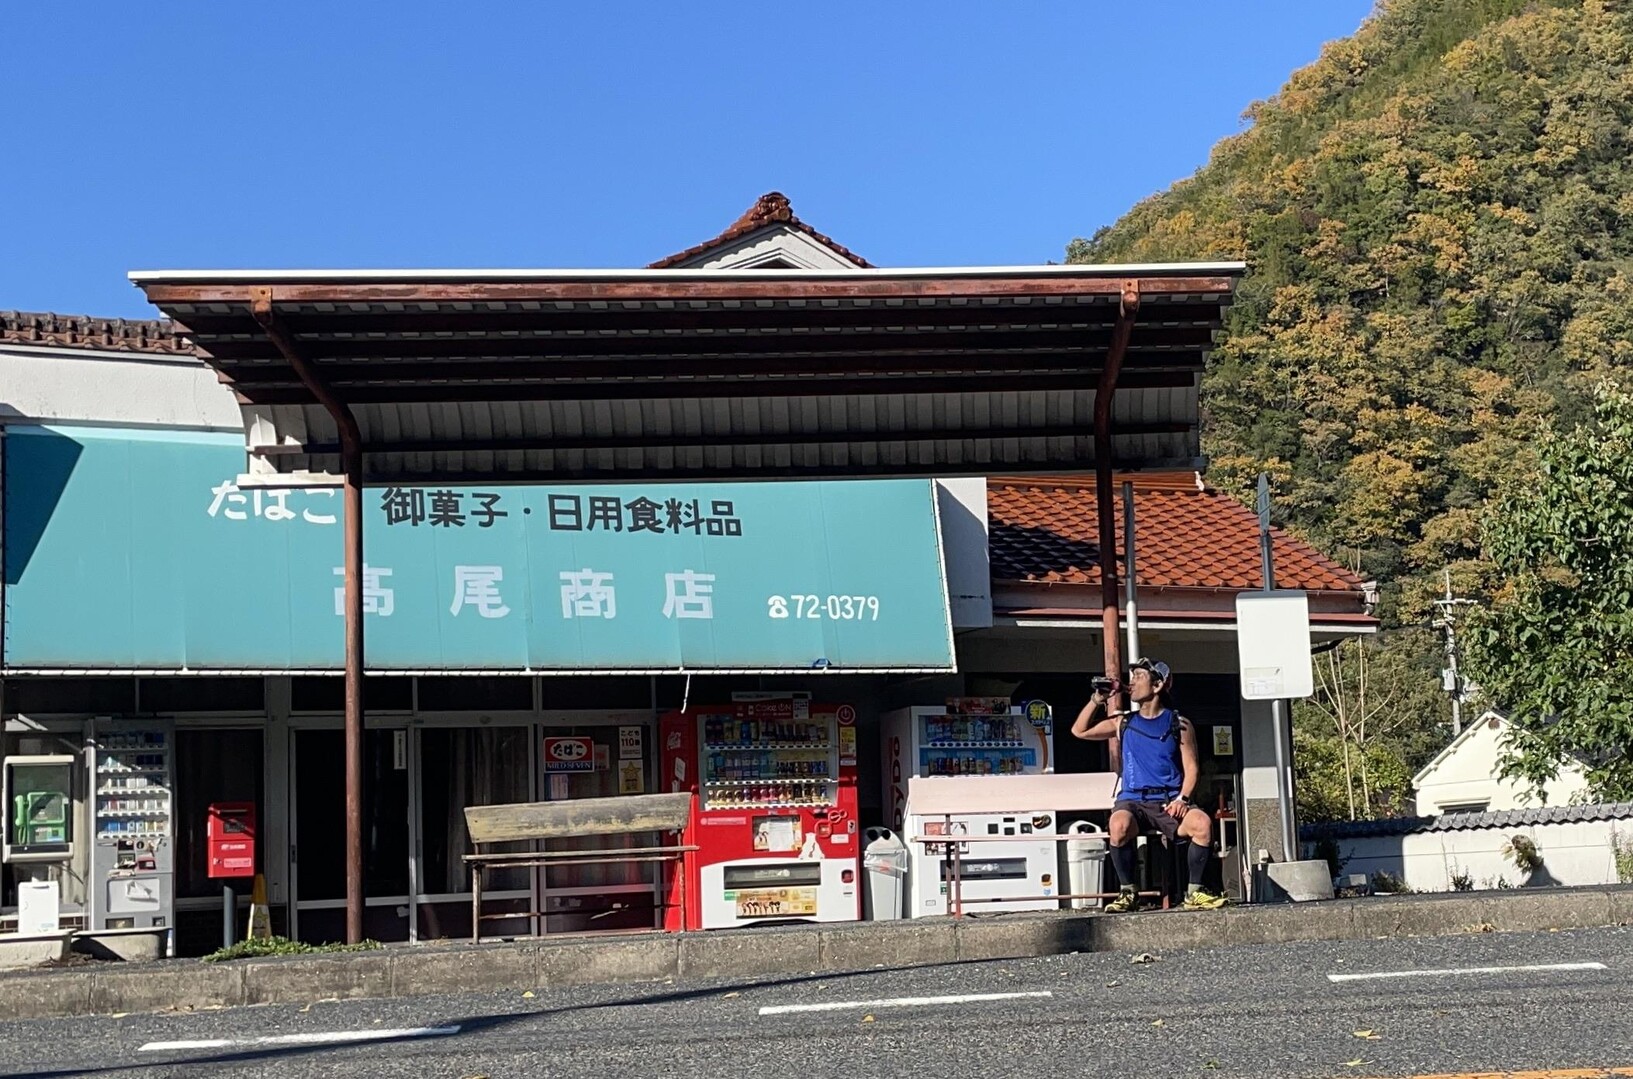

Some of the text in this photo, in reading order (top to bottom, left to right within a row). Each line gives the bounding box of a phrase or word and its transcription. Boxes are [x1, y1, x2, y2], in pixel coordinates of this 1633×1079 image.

[791, 594, 879, 620] 72-0379
[553, 743, 584, 756] たばこ
